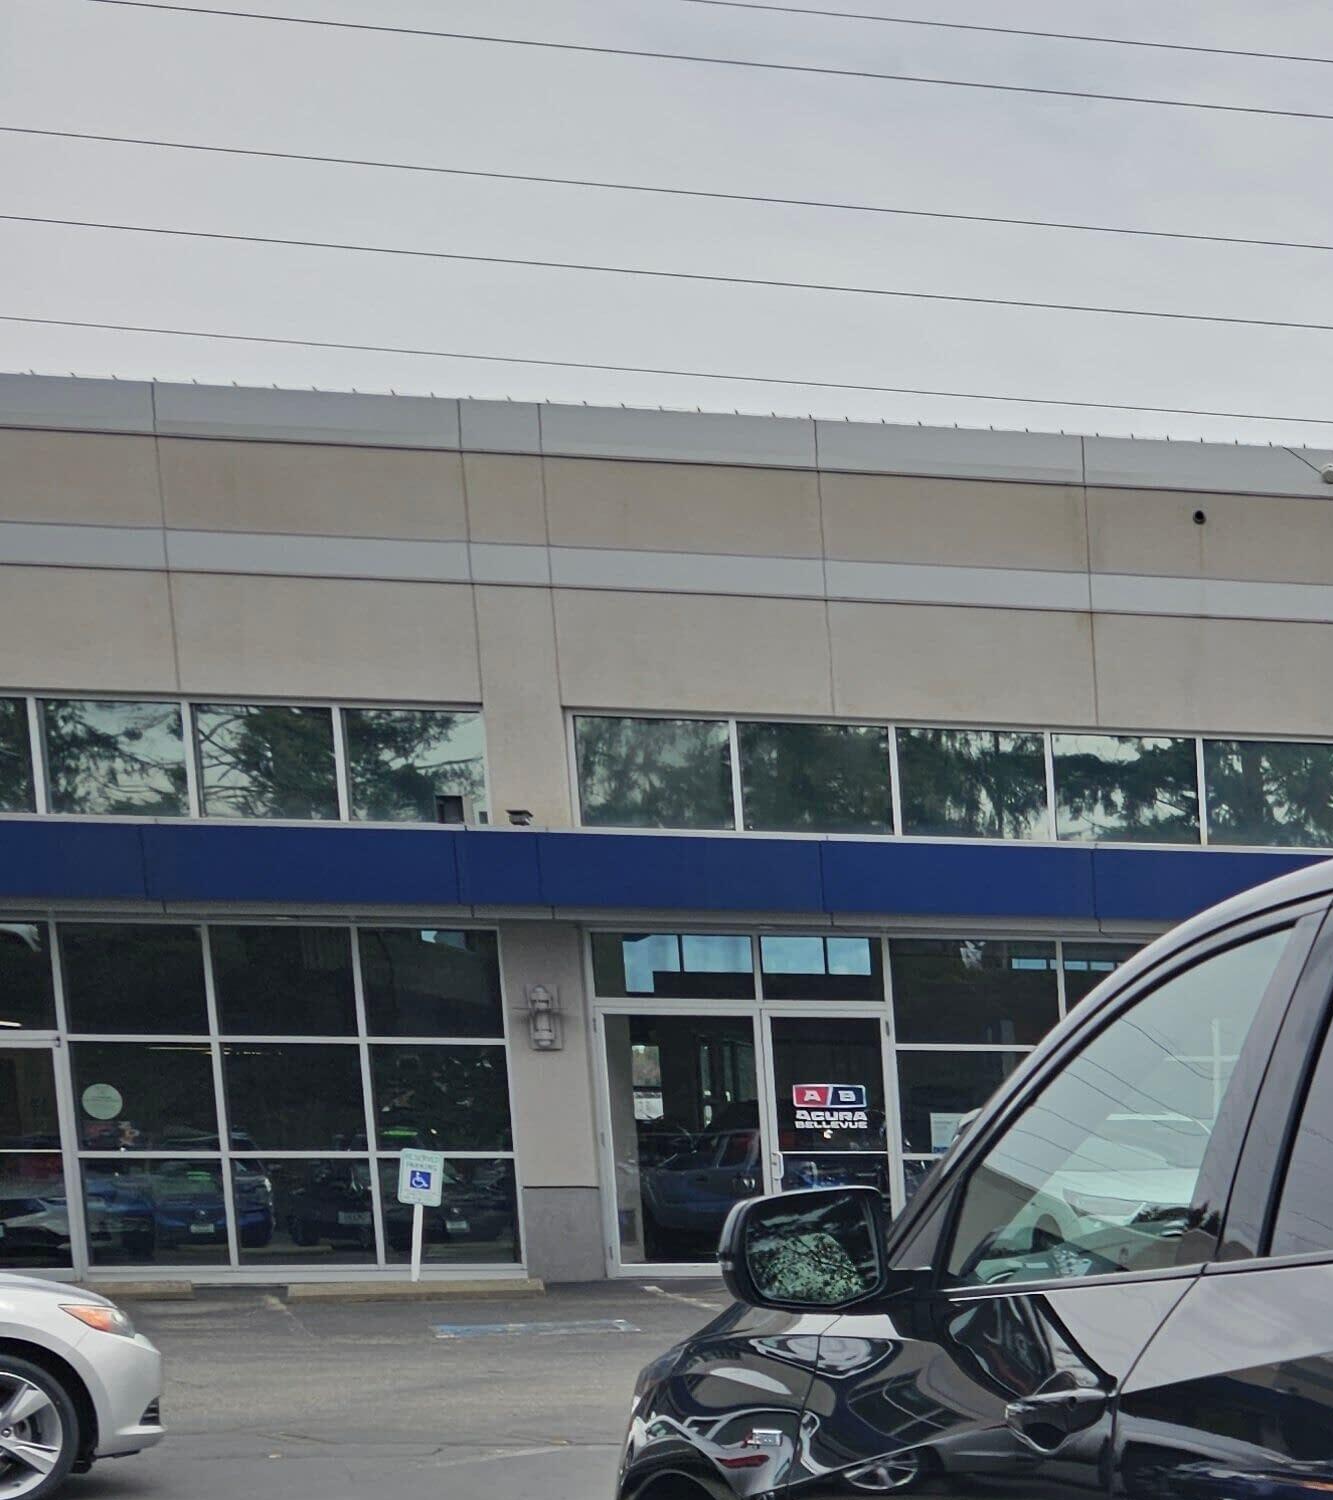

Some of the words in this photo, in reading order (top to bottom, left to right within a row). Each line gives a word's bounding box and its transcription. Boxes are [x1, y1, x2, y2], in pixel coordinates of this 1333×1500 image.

[804, 1090, 821, 1101] A
[838, 1090, 856, 1101] B
[795, 1110, 868, 1121] ACURA
[795, 1121, 868, 1129] BELLEVUE
